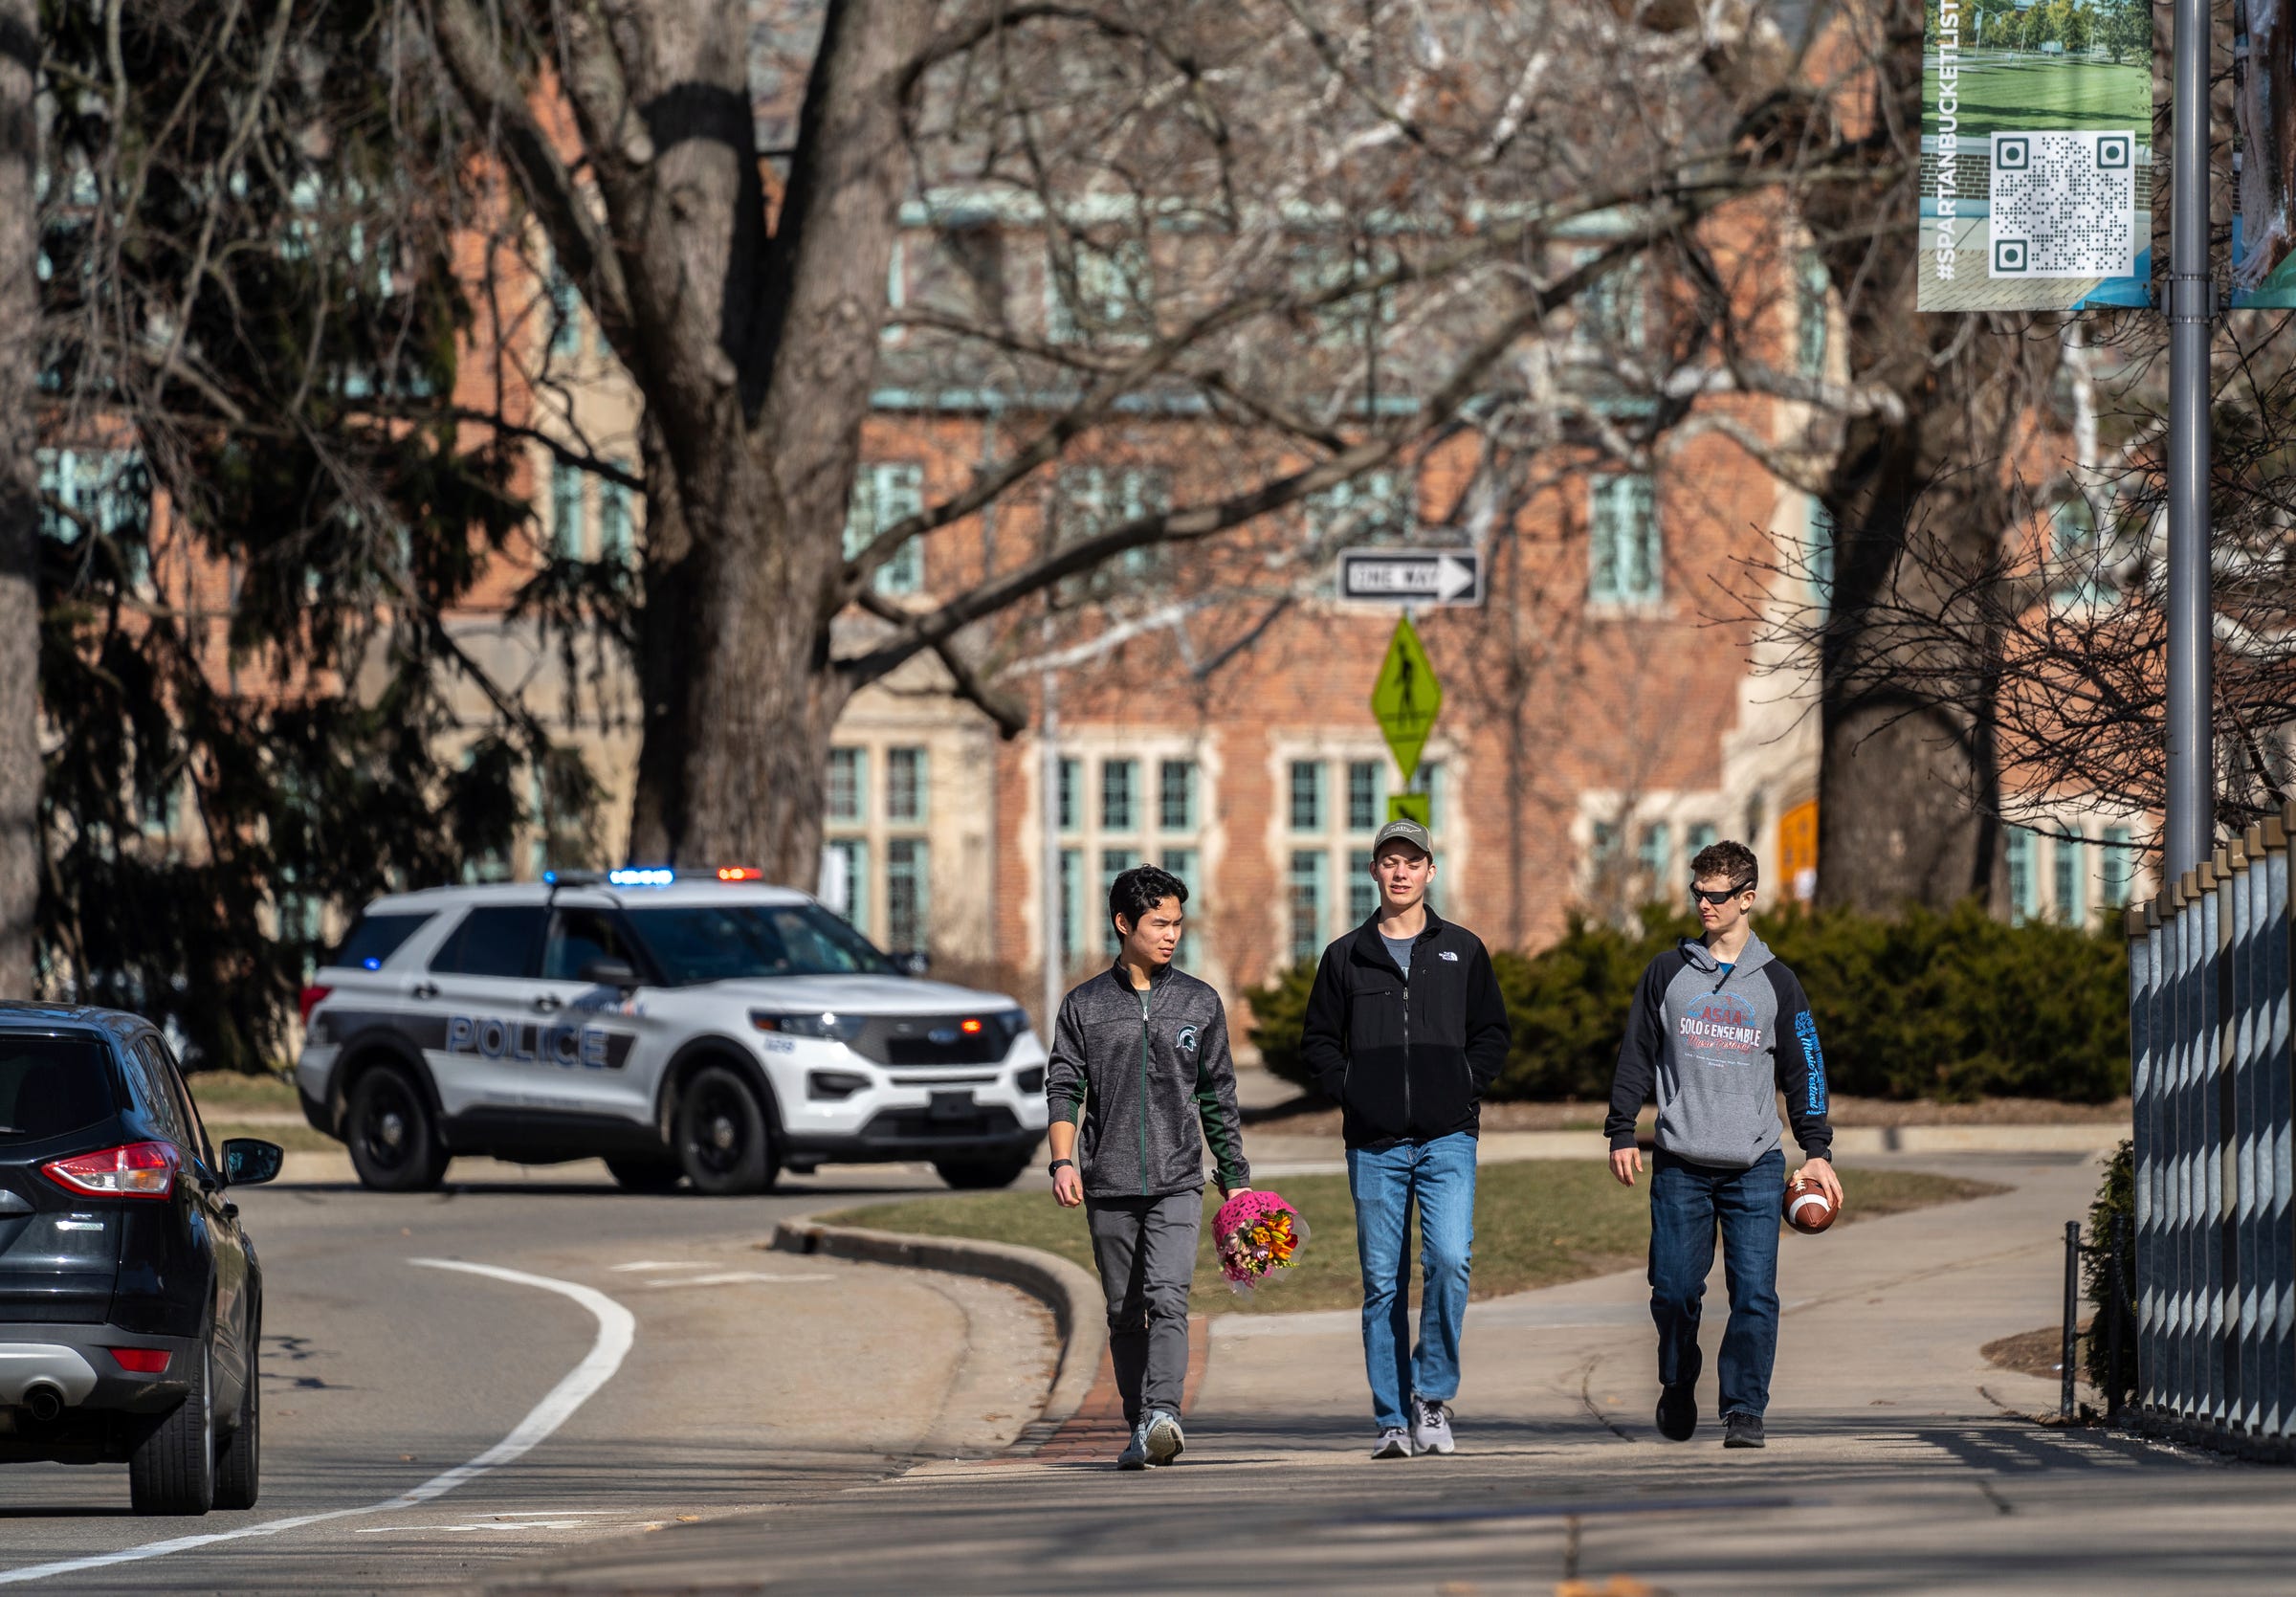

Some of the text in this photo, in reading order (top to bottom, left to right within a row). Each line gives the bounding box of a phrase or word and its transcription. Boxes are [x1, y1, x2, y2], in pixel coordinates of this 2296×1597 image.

[1936, 0, 1959, 280] #SPARTANBUCKETLIST
[1350, 565, 1439, 588] ONE WAY
[1680, 1017, 1761, 1048] SOLO & ENSEMBLE
[1701, 1006, 1741, 1026] ASAA
[447, 1016, 607, 1069] POLICE
[1800, 1037, 1815, 1070] Music
[1808, 1068, 1820, 1110] Festival
